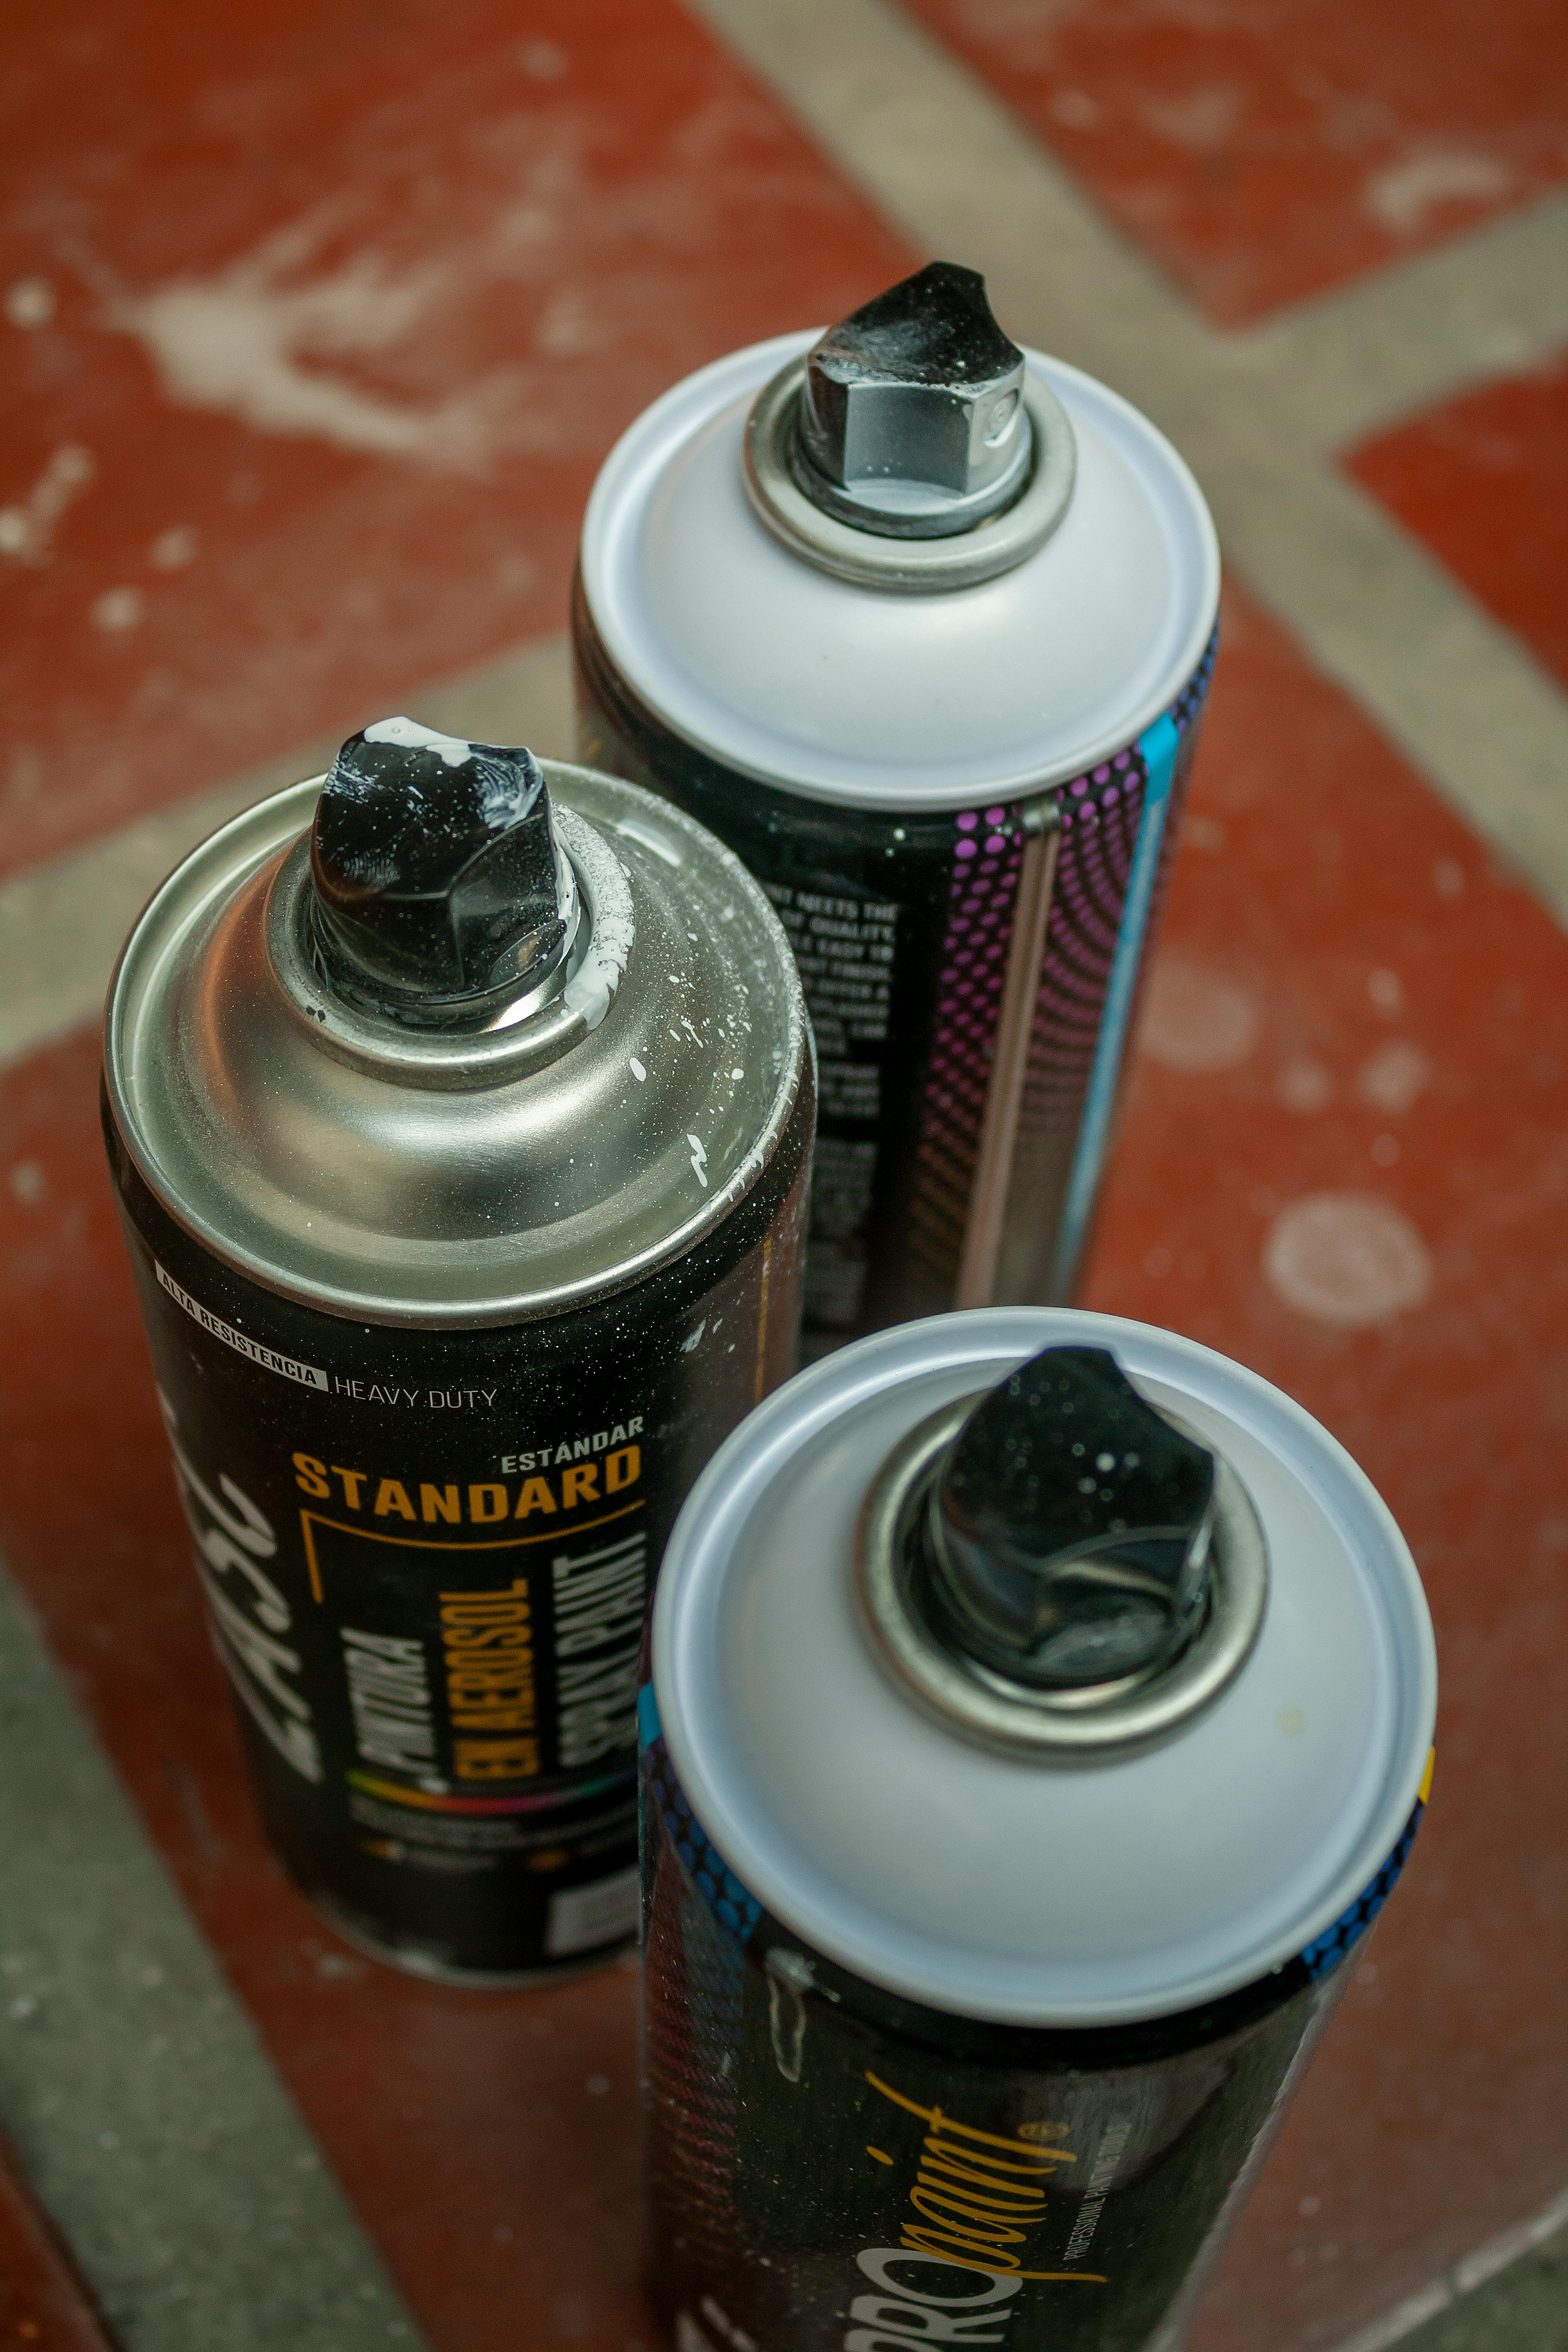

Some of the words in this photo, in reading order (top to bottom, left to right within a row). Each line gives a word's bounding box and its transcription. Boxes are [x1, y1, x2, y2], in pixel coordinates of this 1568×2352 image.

[162, 1270, 195, 1310] ALTA
[200, 1307, 318, 1385] RESISTENCIA
[334, 1376, 419, 1407] HEAVY
[430, 1389, 498, 1408] DUTY
[292, 1445, 641, 1524] STANDARD
[501, 1416, 644, 1474] ESTÁNDAR
[552, 1531, 647, 1656] PAINT
[438, 1578, 536, 1730] AEROSOL
[1063, 2197, 1106, 2261] PROFESSIONAL
